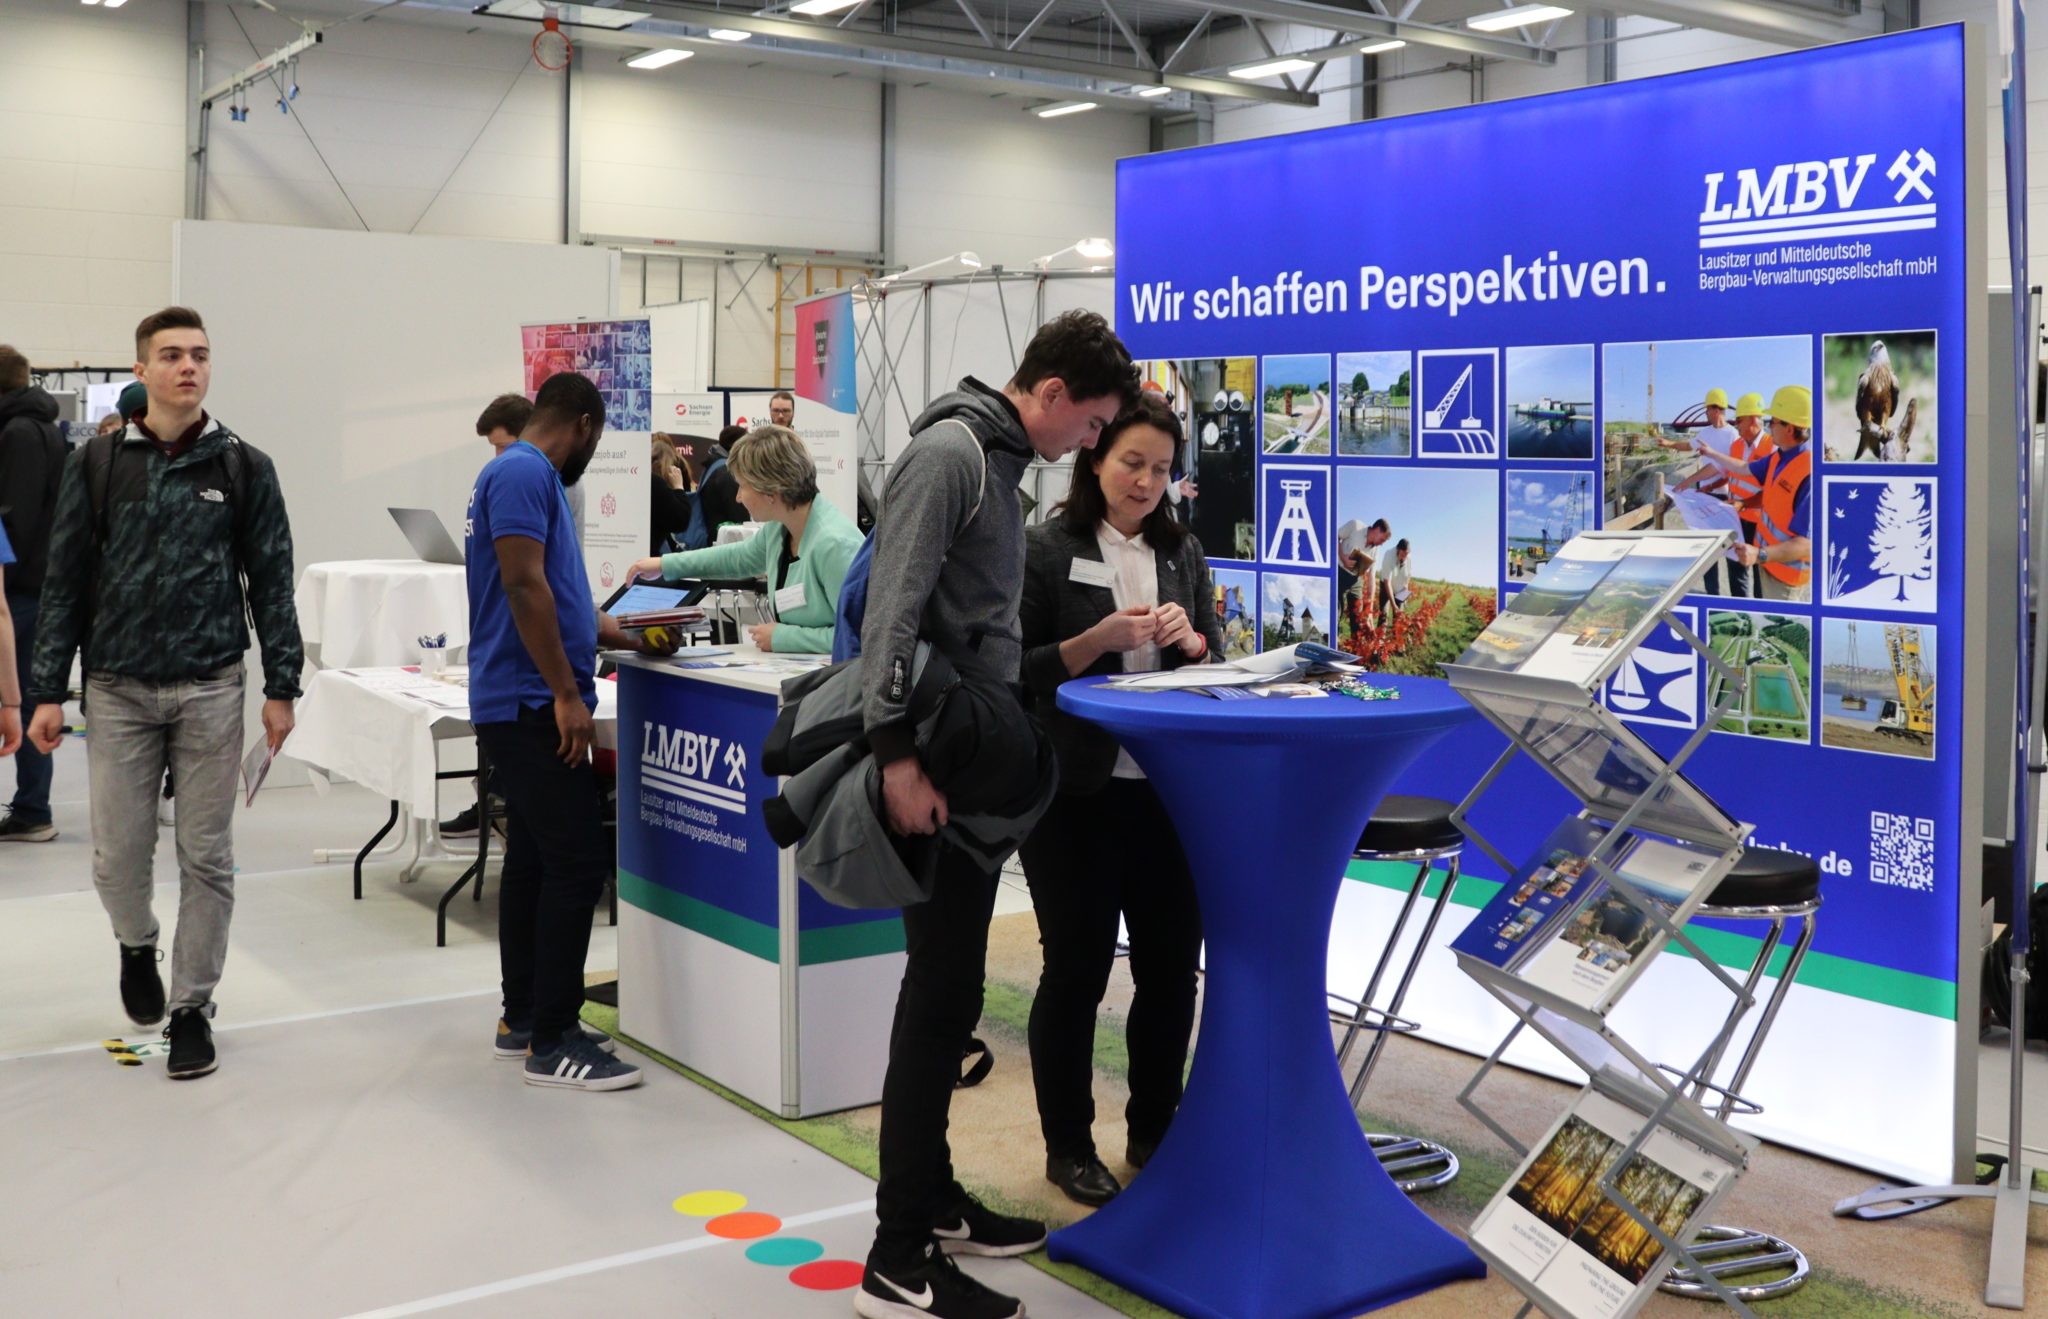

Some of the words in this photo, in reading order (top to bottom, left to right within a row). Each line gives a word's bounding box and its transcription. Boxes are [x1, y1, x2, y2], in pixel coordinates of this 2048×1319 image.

[1700, 153, 1877, 223] LMBV
[1699, 252, 1752, 271] Lausitzer
[1755, 248, 1777, 267] und
[1781, 241, 1871, 264] Mitteldeutsche
[1699, 258, 1903, 292] Bergbau-Verwaltungsgesellschaft
[1905, 255, 1937, 276] mbH
[1130, 280, 1185, 323] Wir
[1193, 270, 1348, 320] schaffen
[1360, 250, 1666, 317] Perspektiven.
[752, 416, 772, 427] Sachs
[641, 720, 720, 781] LMBV
[641, 788, 664, 809] Lausitzer
[664, 799, 676, 813] und
[676, 800, 718, 826] Mitteldeutsche
[641, 805, 732, 849] Bergbau-Verwaltungsgesellschaft
[732, 835, 747, 853] mbH
